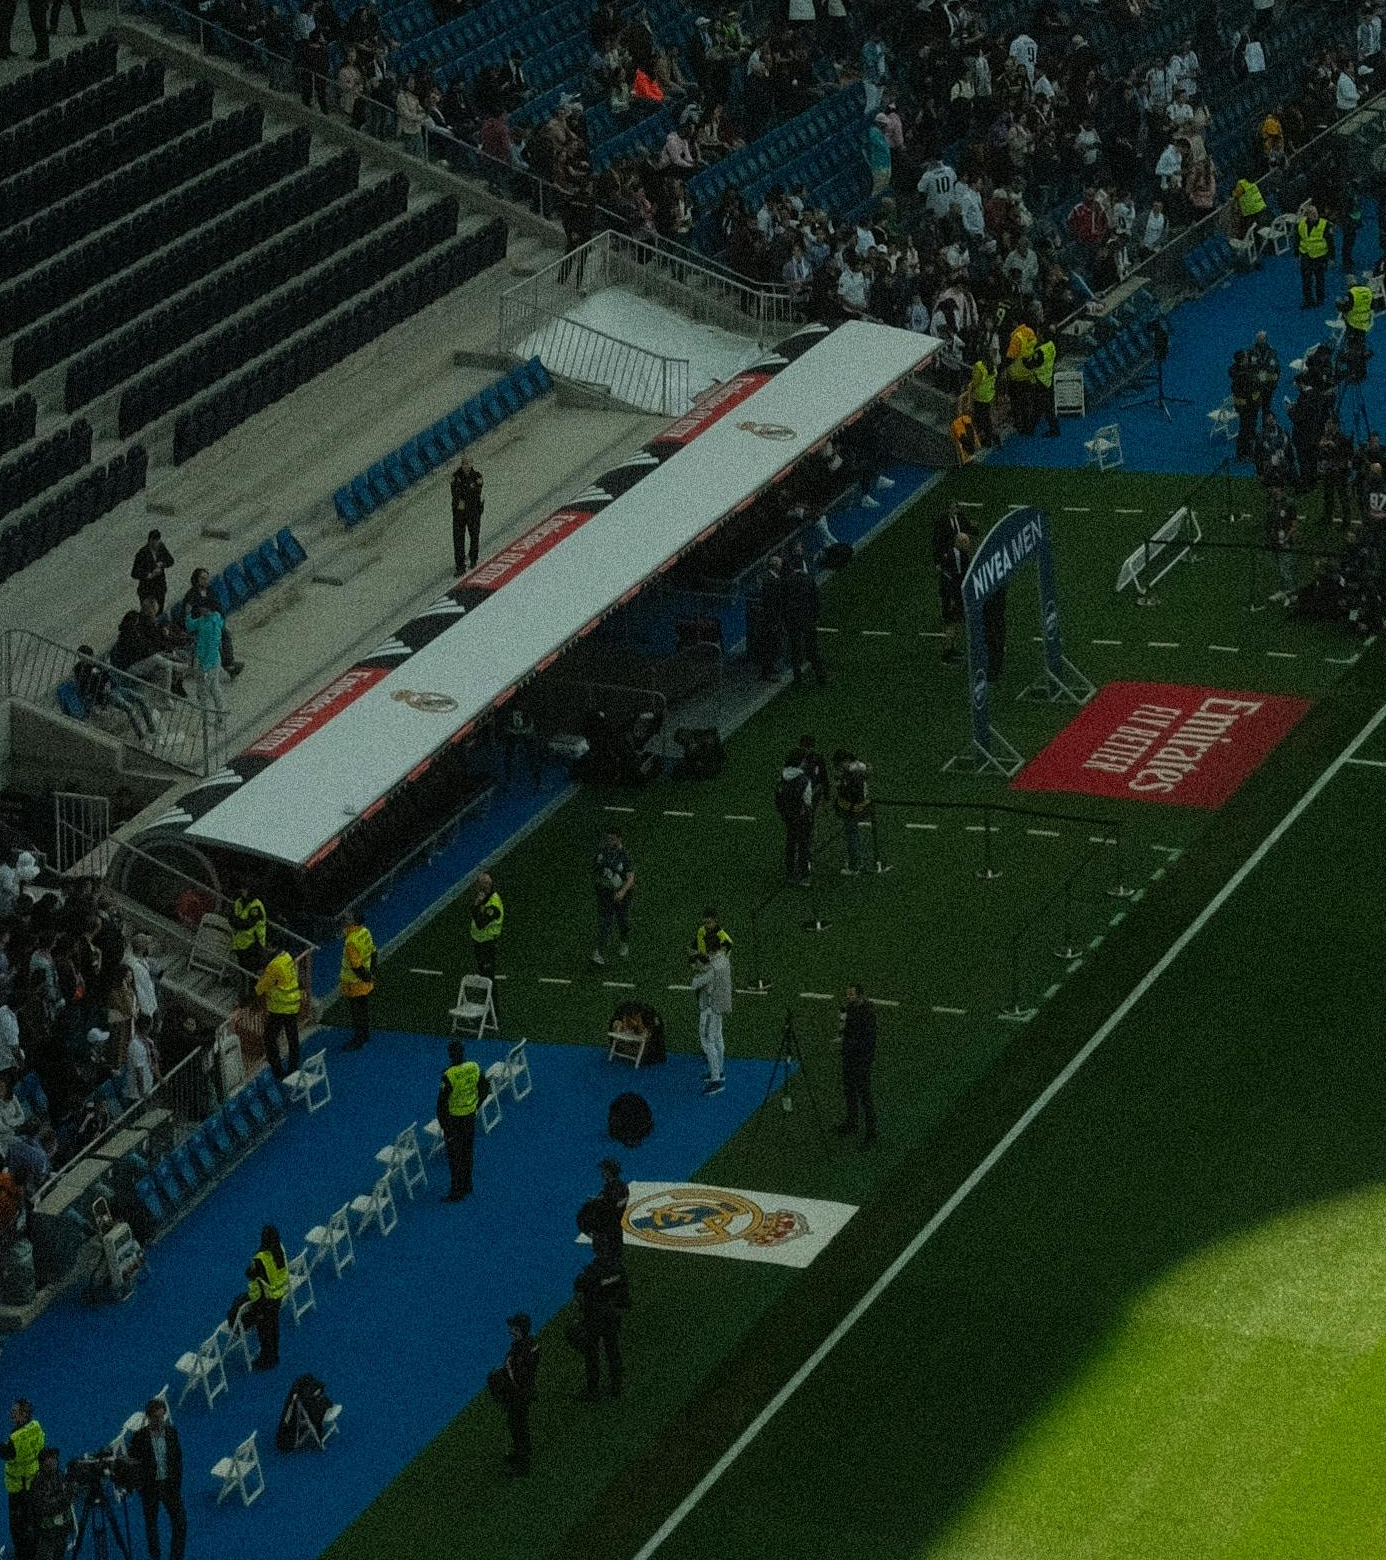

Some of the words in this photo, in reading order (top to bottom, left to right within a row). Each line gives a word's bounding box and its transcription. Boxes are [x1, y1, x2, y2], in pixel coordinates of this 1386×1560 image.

[935, 176, 951, 194] 10
[972, 543, 1013, 600] NIVEA
[1011, 514, 1044, 563] MEN
[1127, 703, 1183, 729] FLY
[1082, 724, 1161, 775] BETTER
[1128, 697, 1264, 794] Emirates
